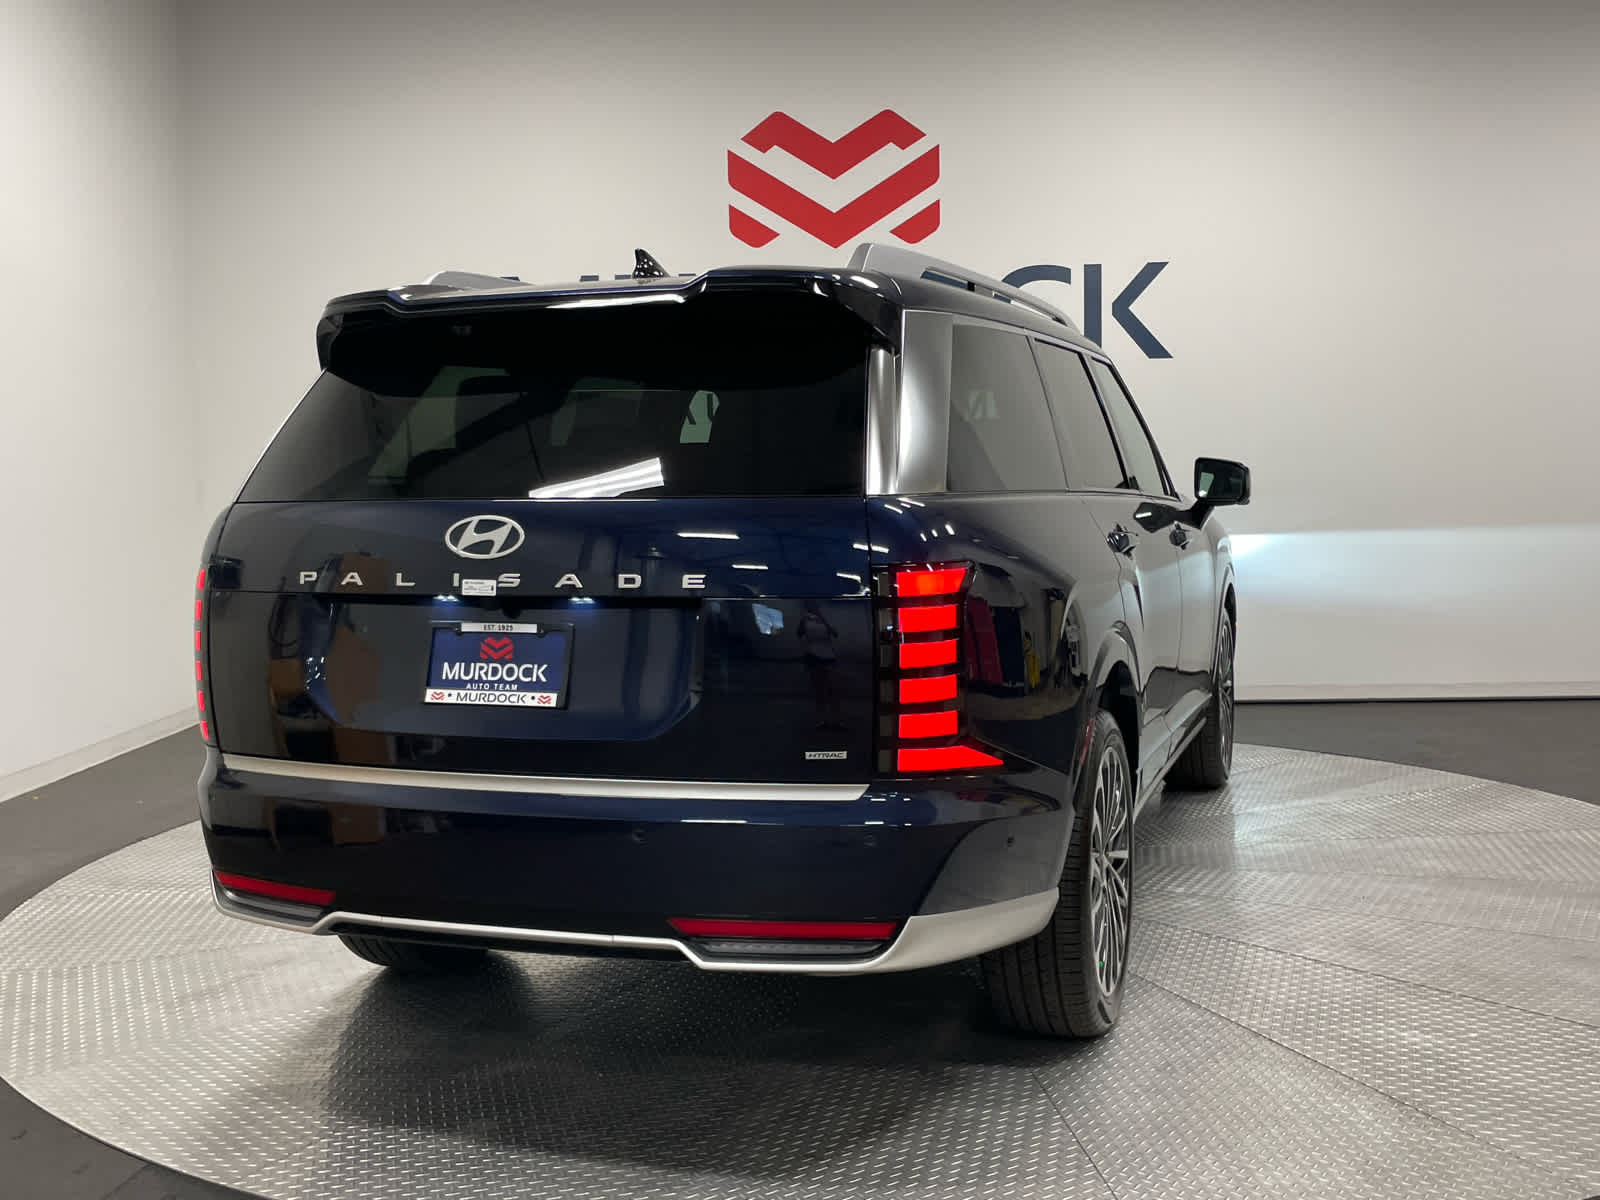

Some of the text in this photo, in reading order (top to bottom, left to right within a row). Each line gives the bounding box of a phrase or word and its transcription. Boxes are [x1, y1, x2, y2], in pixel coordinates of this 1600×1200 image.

[299, 570, 707, 590] PALISADE
[442, 662, 547, 682] MURDOCK
[456, 692, 527, 704] MURDOCK
